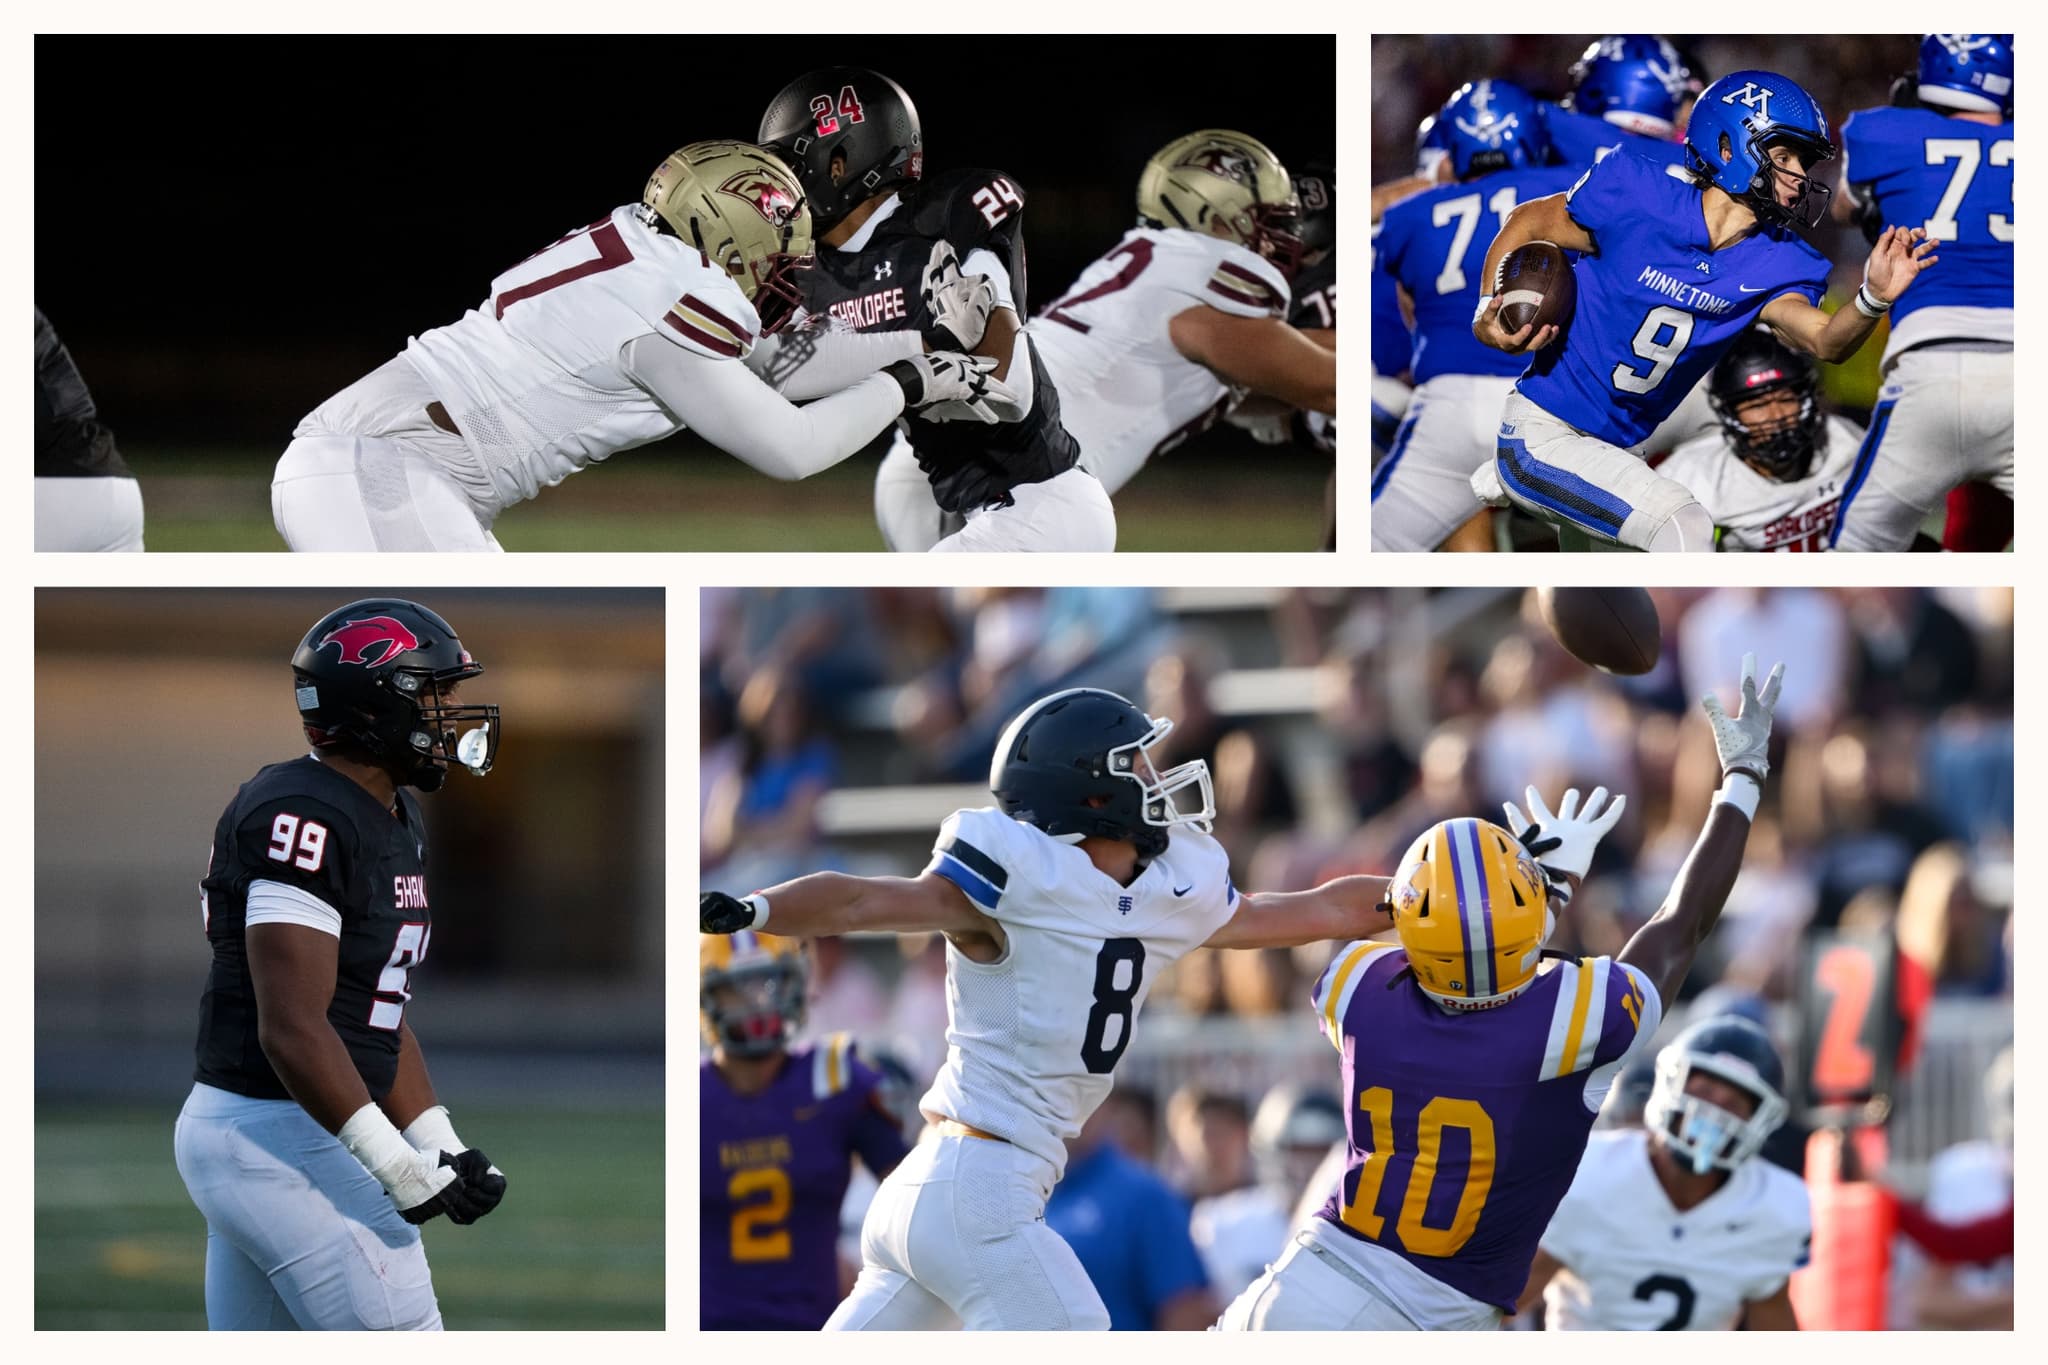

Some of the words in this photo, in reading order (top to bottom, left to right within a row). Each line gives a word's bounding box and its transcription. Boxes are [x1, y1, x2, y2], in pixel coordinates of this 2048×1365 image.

[810, 86, 864, 138] 24
[972, 177, 1024, 231] 24
[1293, 176, 1328, 211] 3
[495, 215, 635, 321] 7
[1040, 237, 1155, 335] 2
[1612, 305, 1696, 395] 9
[267, 814, 328, 873] 99
[368, 923, 431, 1031] 9
[1080, 937, 1146, 1075] 8
[1443, 991, 1518, 1010] Riddell
[1812, 946, 1876, 1095] 2
[728, 1167, 792, 1263] 2
[1340, 1086, 1496, 1258] 10
